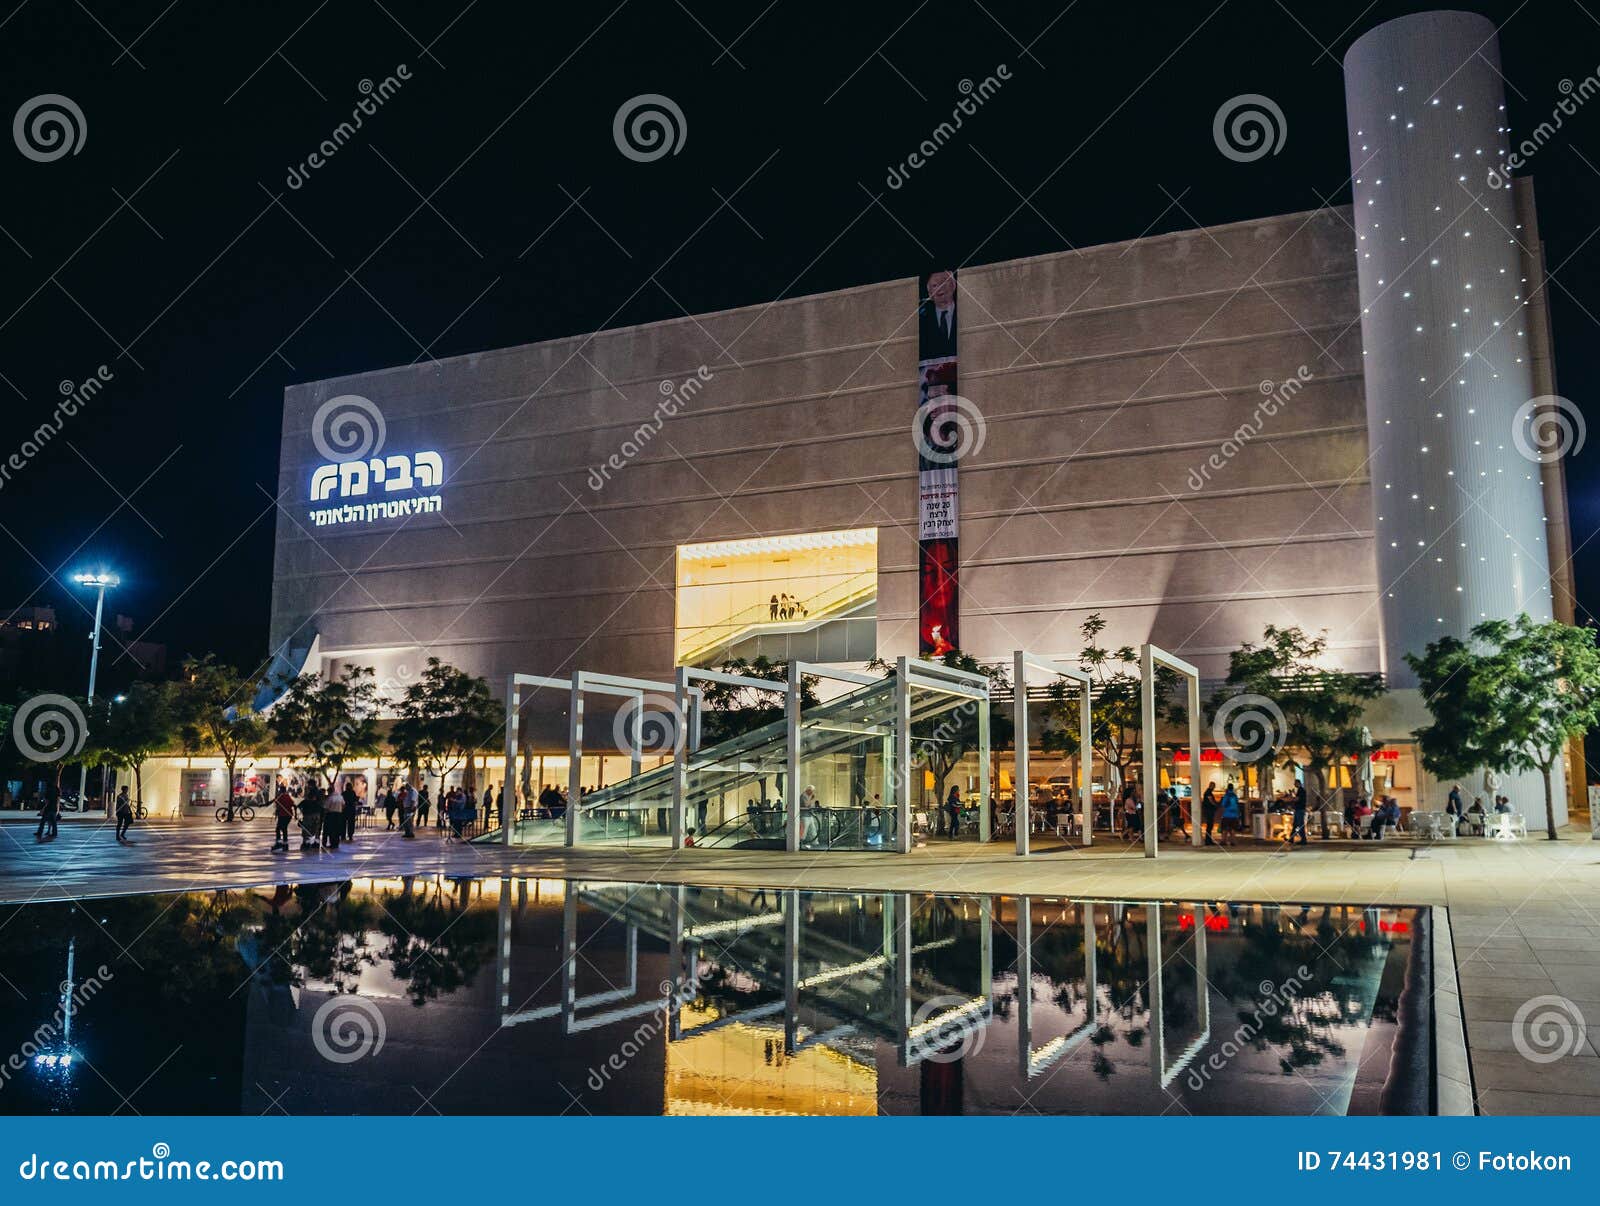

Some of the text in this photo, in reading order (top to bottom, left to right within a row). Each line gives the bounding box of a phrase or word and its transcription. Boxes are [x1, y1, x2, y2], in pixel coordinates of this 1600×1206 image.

[309, 495, 442, 526] התיאטרון הלאומי
[926, 502, 940, 510] שנה
[929, 510, 948, 518] לרצח
[923, 519, 954, 530] יצחק רבין
